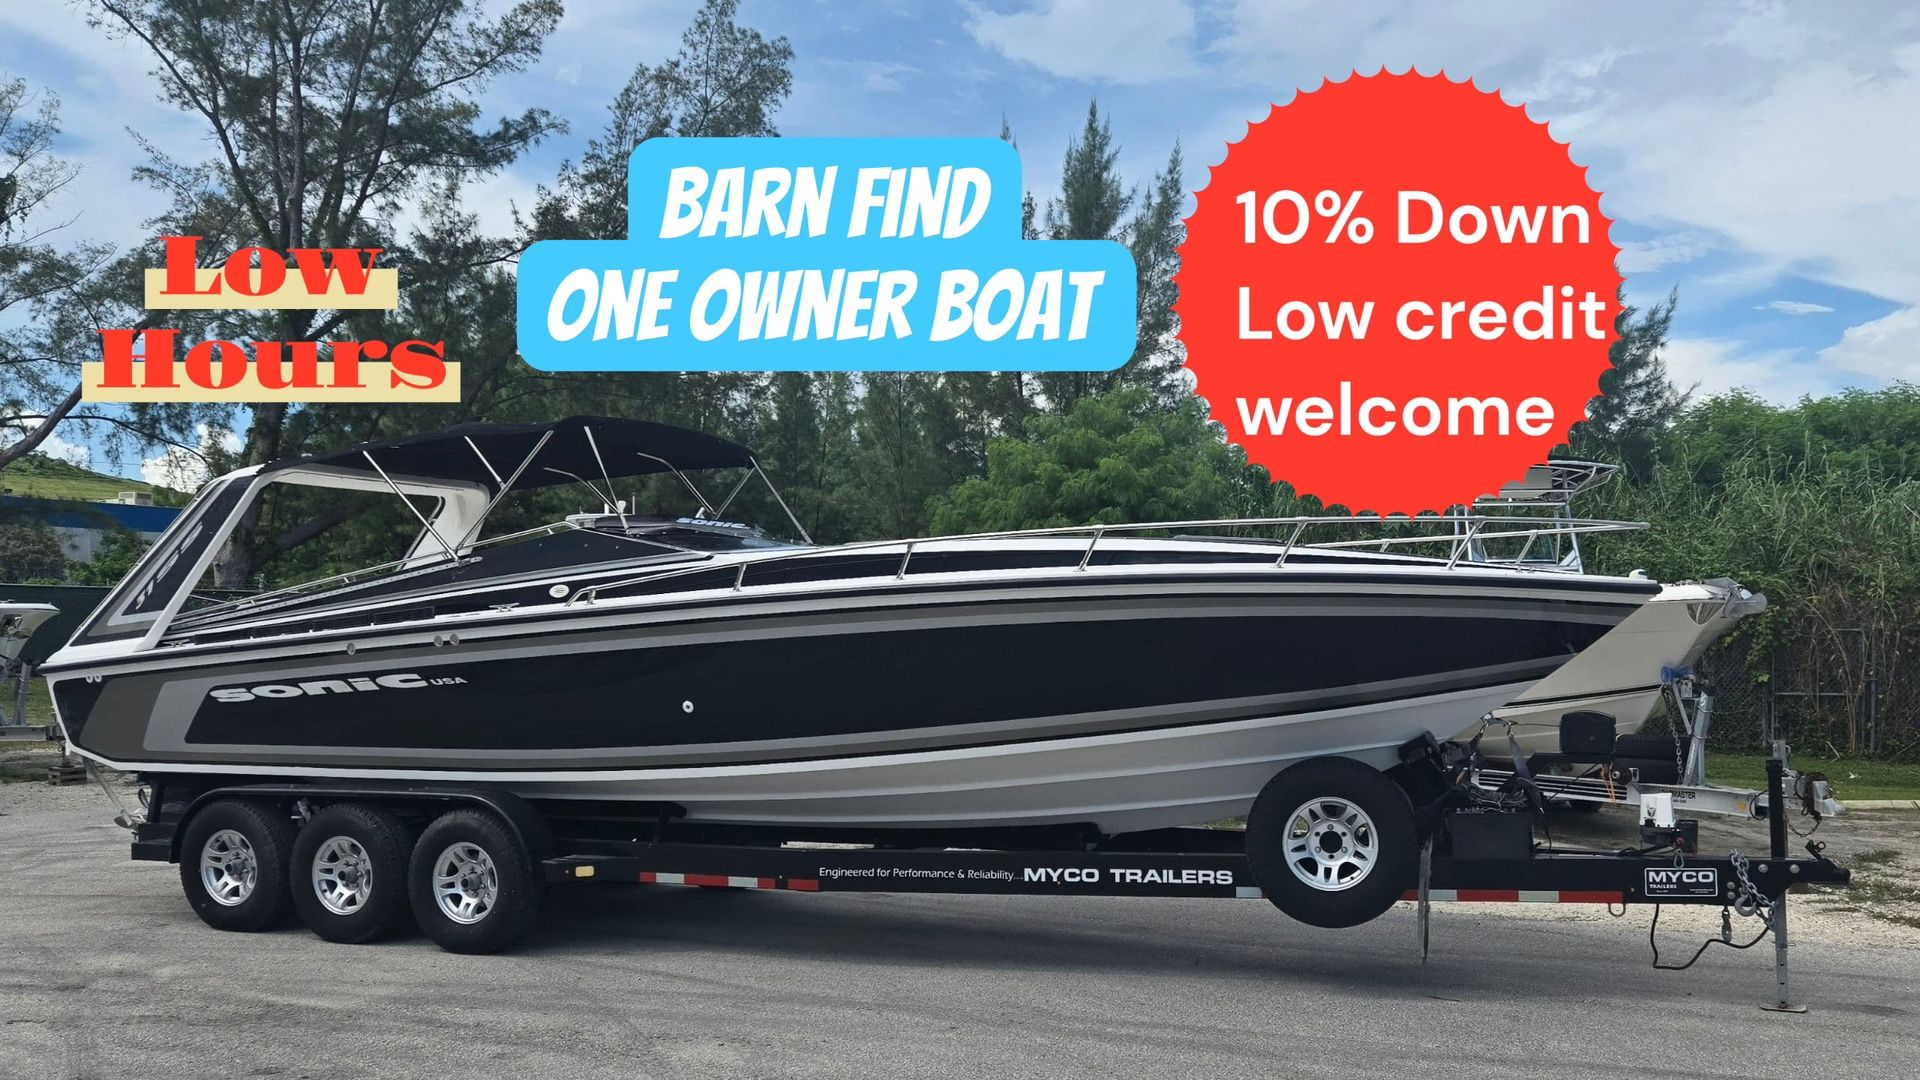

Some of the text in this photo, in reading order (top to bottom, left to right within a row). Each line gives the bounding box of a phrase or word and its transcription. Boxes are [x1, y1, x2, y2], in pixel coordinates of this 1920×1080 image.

[430, 676, 468, 687] USA
[819, 867, 875, 879] Engineered
[877, 867, 892, 878] for
[893, 867, 955, 879] Performance
[957, 869, 966, 879] &
[1024, 867, 1100, 883] MYCO
[1109, 868, 1234, 885] TRAILERS
[1648, 871, 1715, 883] MYCO
